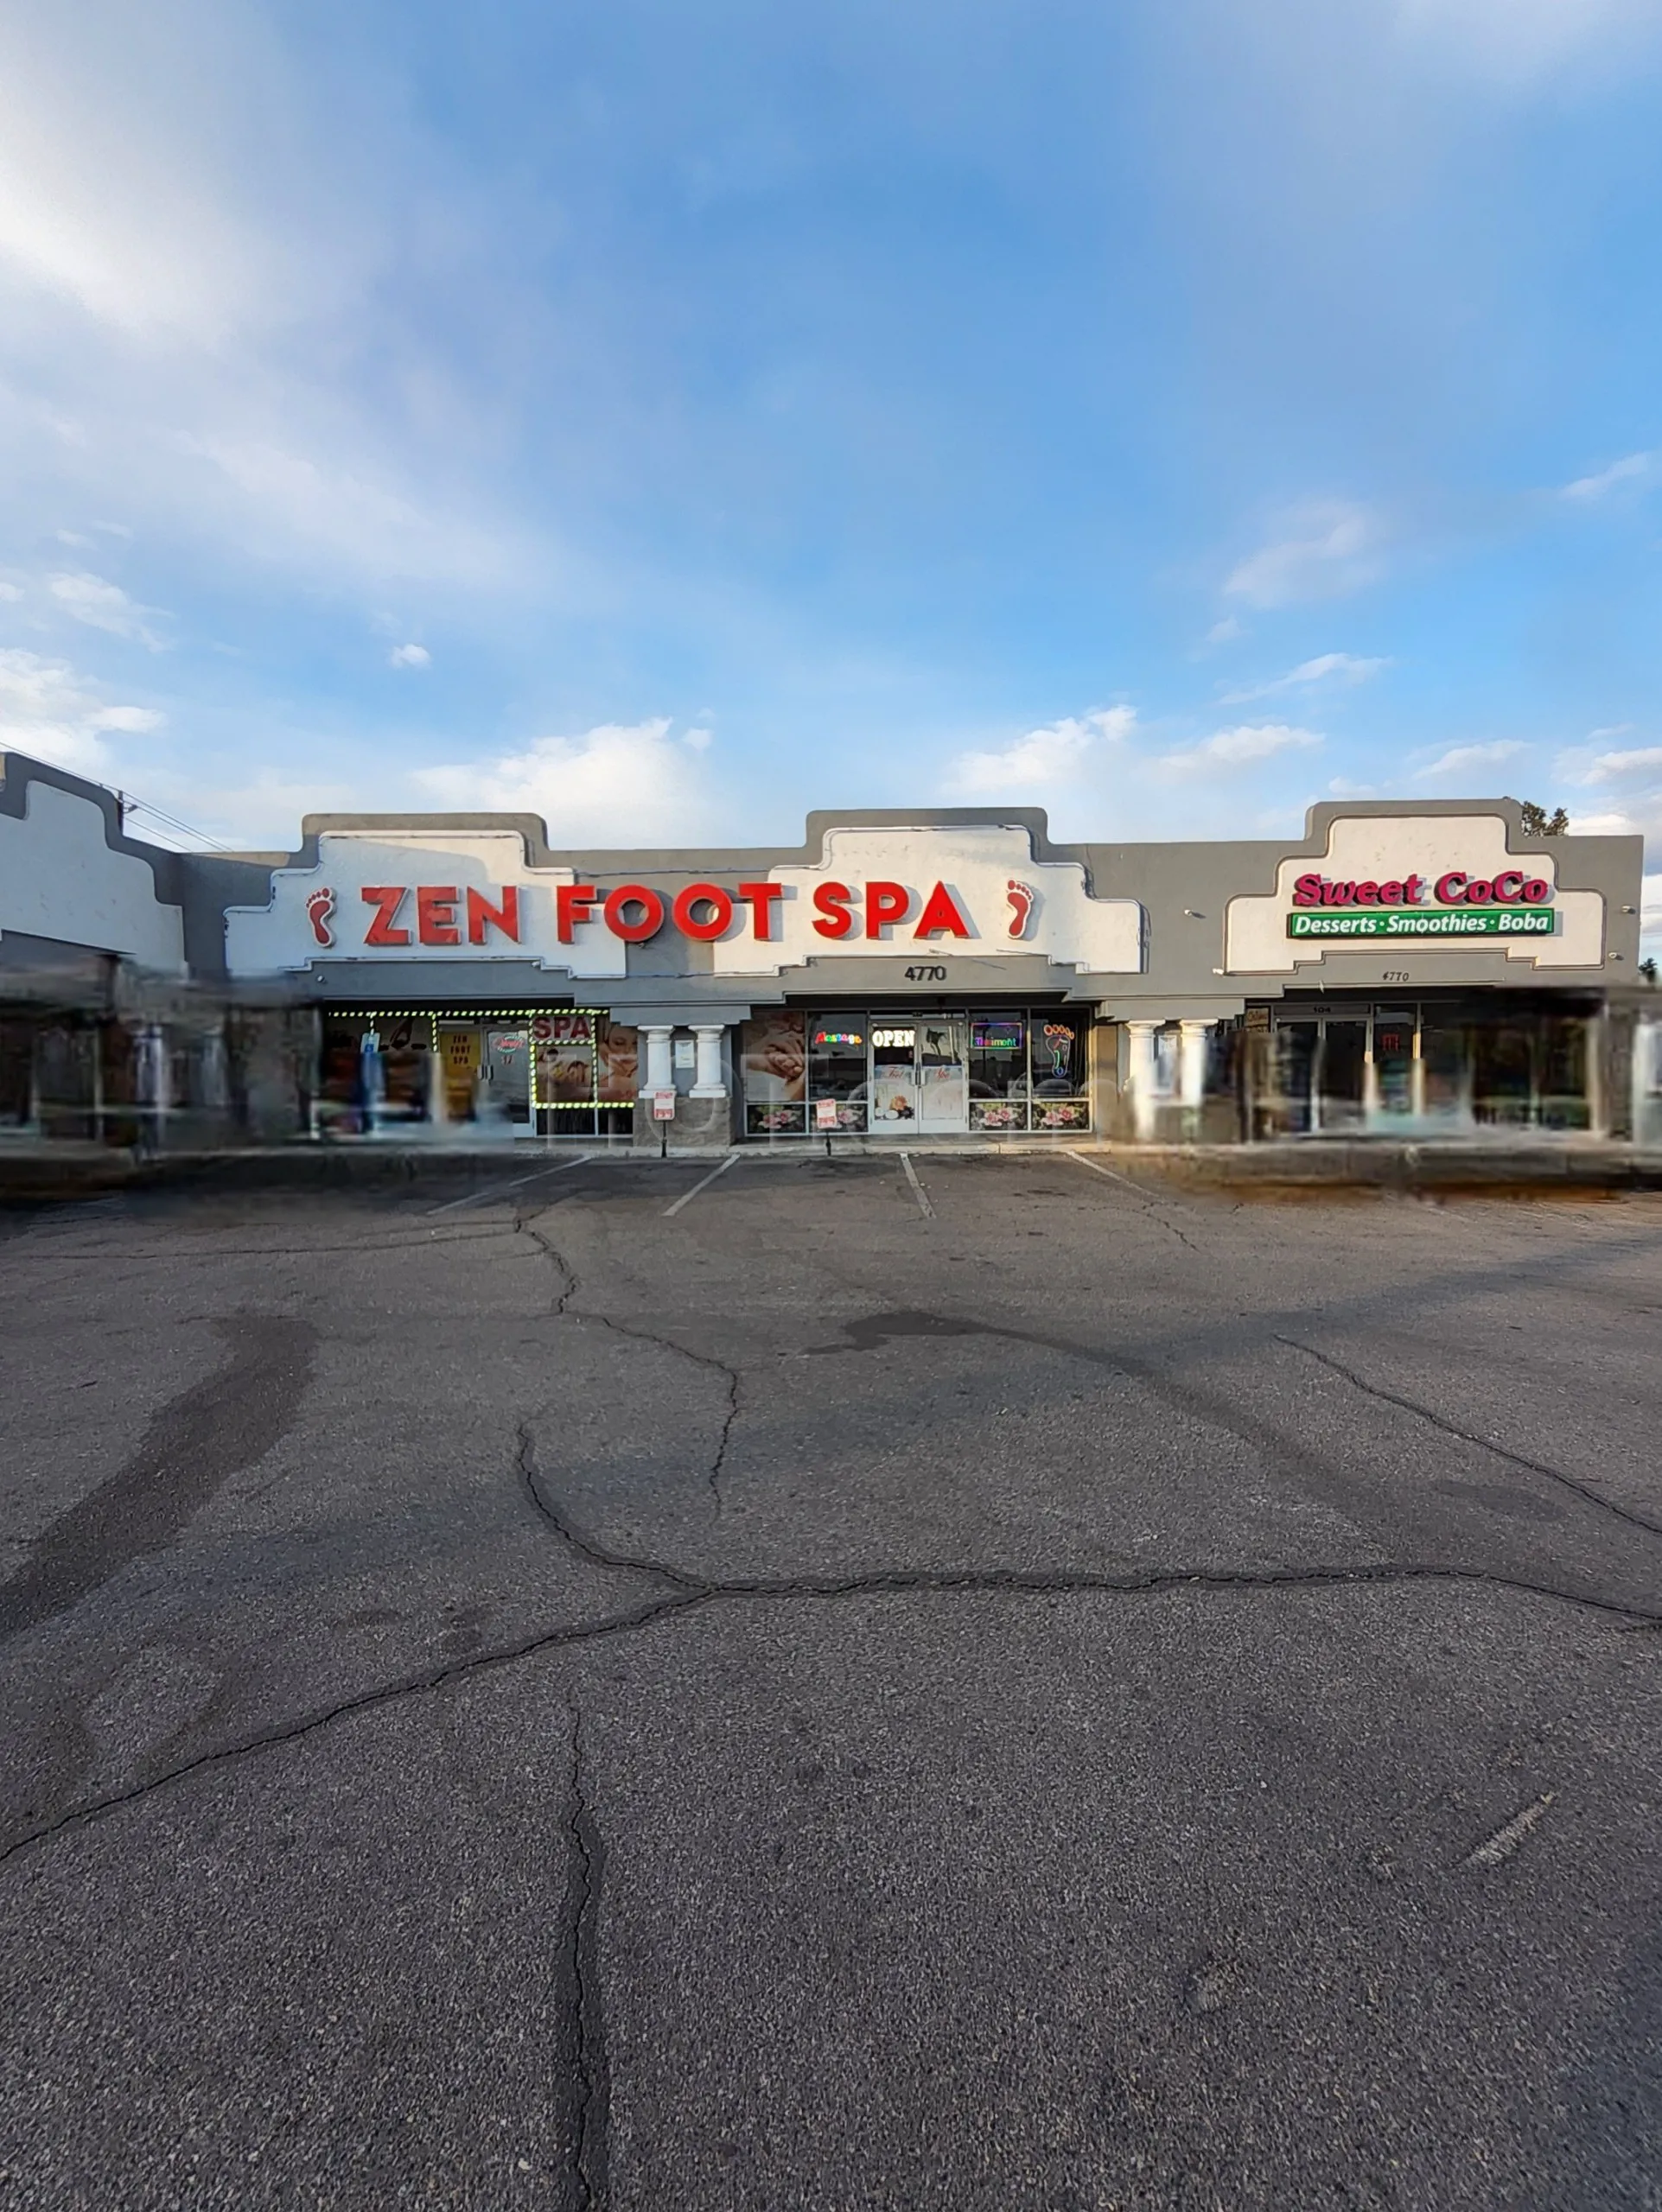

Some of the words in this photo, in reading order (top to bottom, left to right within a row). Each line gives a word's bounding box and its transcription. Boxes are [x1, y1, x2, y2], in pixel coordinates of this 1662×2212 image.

[1292, 872, 1424, 907] Sweet
[1435, 870, 1551, 906] CoCo
[361, 885, 521, 945] ZEN
[557, 882, 782, 944] FOOT
[812, 880, 970, 940] SPA
[1295, 913, 1378, 934] Desserts
[1385, 912, 1487, 933] Smoothies
[1498, 912, 1550, 931] Boba
[904, 965, 947, 982] 4770
[1382, 970, 1410, 982] 4770
[534, 1015, 591, 1039] SPA
[872, 1030, 916, 1047] OPEN
